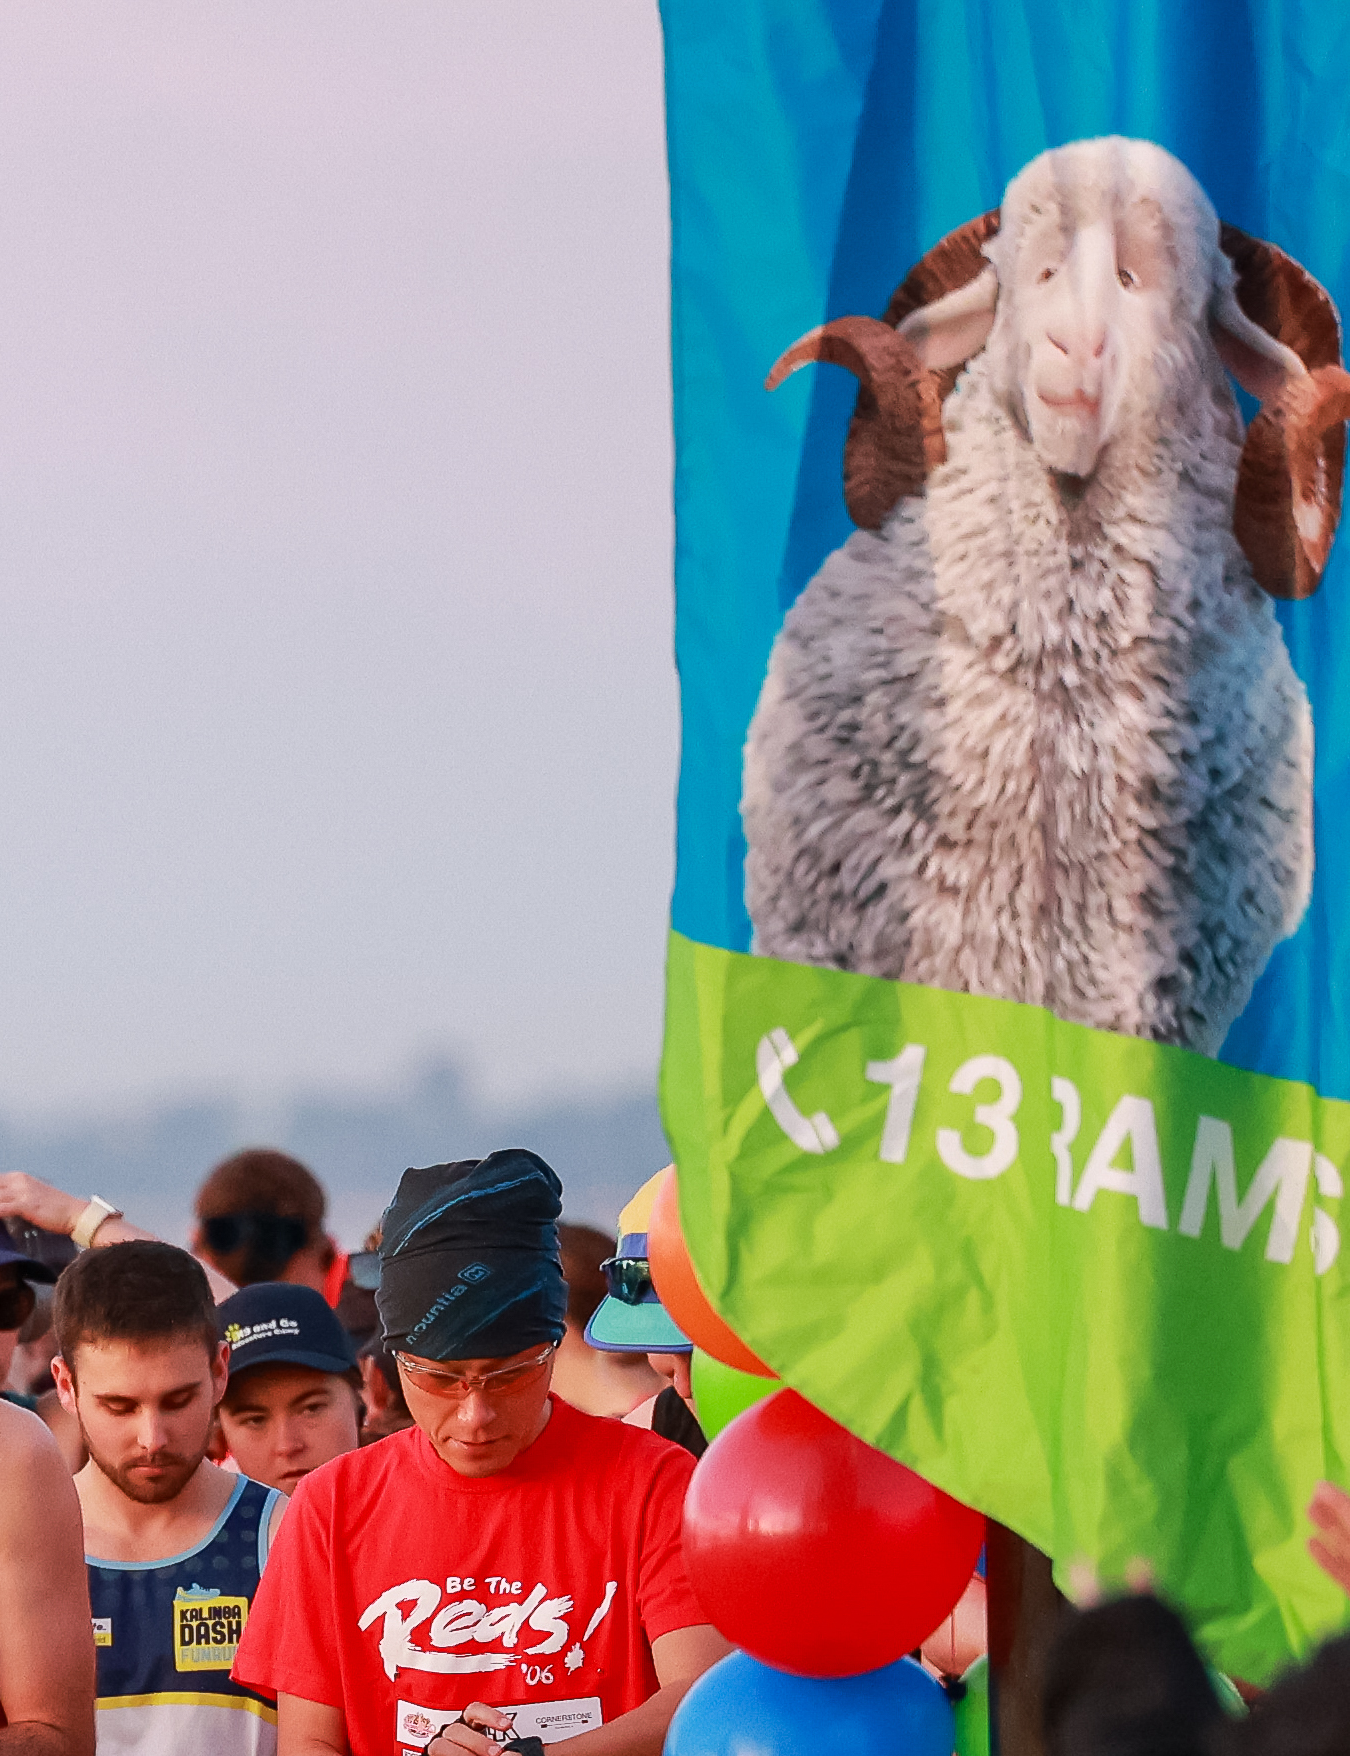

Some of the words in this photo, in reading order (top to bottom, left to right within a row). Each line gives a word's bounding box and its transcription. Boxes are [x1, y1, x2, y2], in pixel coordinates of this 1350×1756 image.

[864, 1043, 1022, 1180] 13
[445, 1576, 477, 1594] Be
[484, 1576, 523, 1595] The
[179, 1619, 242, 1647] DASH
